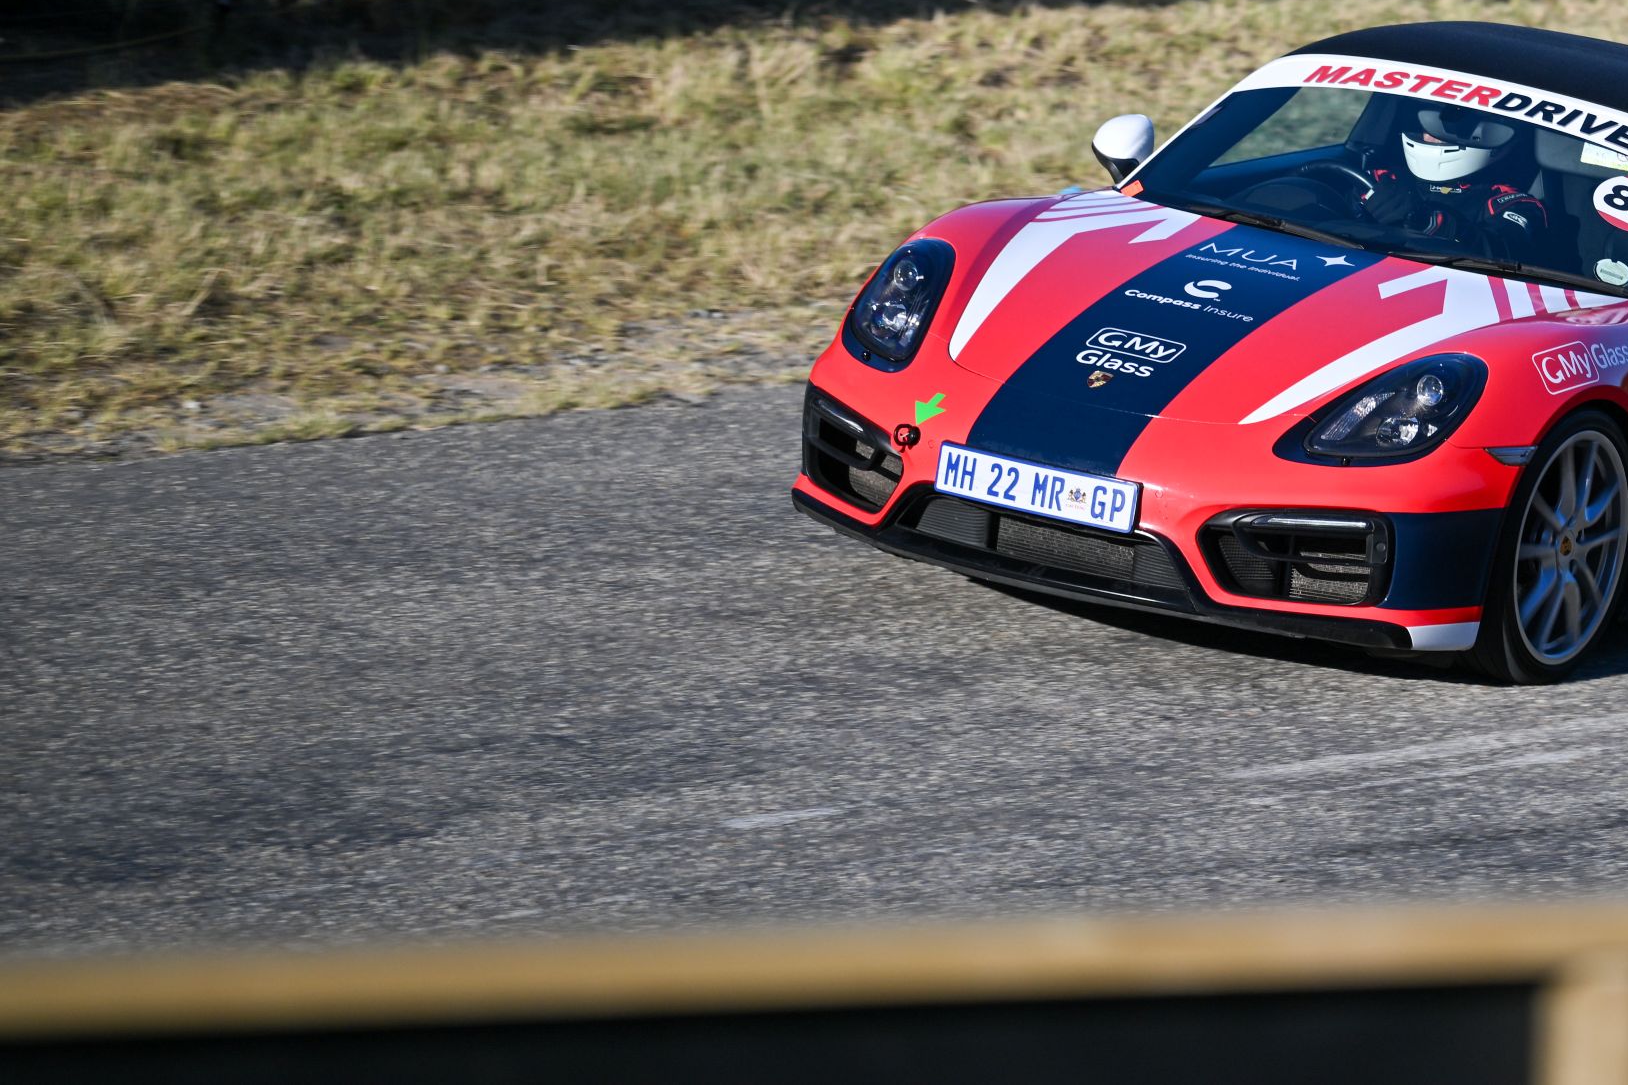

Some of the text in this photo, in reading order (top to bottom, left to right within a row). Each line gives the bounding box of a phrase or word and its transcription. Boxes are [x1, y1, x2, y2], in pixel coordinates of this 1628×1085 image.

[1199, 241, 1299, 271] MUA
[1124, 289, 1254, 322] Compass Insure
[1076, 349, 1154, 377] Glass
[943, 451, 1126, 522] MH 22 MR GP
